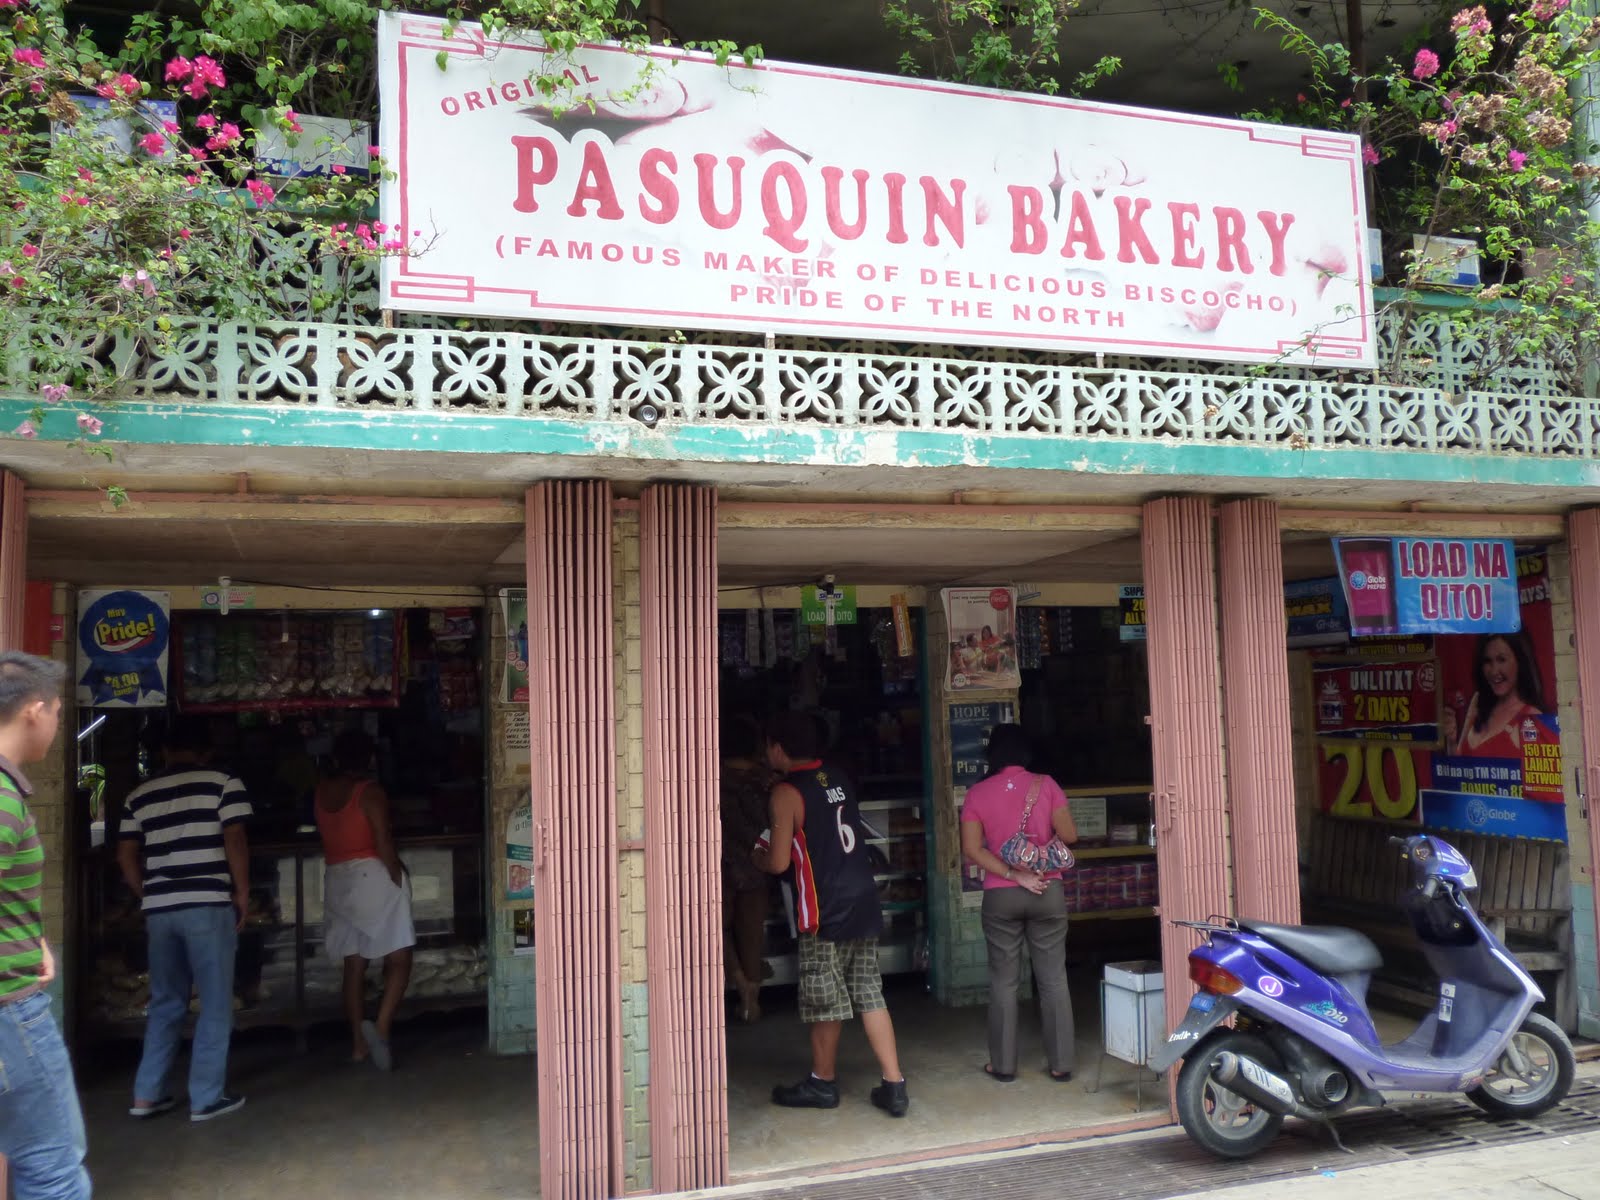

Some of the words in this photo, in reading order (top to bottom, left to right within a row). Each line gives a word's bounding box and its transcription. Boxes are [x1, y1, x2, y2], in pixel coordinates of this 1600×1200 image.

[440, 65, 599, 116] ORIGIAL
[511, 134, 967, 254] PASUQUIN
[1007, 184, 1295, 276] BAKERY
[495, 235, 681, 267] (FAMOUS
[704, 251, 835, 278] MAKER
[857, 263, 894, 282] OF
[920, 269, 1106, 298] DELICIOUS
[1125, 284, 1298, 318] BISCOCHO)
[731, 285, 843, 309] PRIDE
[864, 293, 903, 312] OF
[927, 299, 993, 319] THE
[1013, 304, 1125, 328] NORTH
[1398, 541, 1467, 579] LOAD
[1473, 542, 1509, 579] NA
[1367, 576, 1386, 584] Globe
[1519, 577, 1552, 604] AYS!
[1124, 586, 1144, 596] SUPE
[1420, 583, 1493, 621] DITO!
[807, 611, 826, 622] LOAD
[836, 611, 853, 622] DITO
[98, 613, 156, 645] Pride!
[1350, 670, 1414, 691] UNLITXT
[953, 706, 990, 720] HOPE
[1353, 693, 1365, 721] 2
[1367, 696, 1410, 722] DAYS
[1523, 745, 1540, 757] 150
[1450, 766, 1463, 778] na
[1463, 767, 1474, 780] ng
[1474, 766, 1490, 779] TM
[1490, 767, 1509, 781] SIM
[1524, 757, 1554, 772] LAHAT
[1325, 745, 1418, 819] 20
[1461, 782, 1497, 796] BONUS
[1525, 771, 1563, 786] NETWOR
[1488, 808, 1517, 821] Globe
[836, 805, 856, 854] 6
[1264, 981, 1278, 994] J
